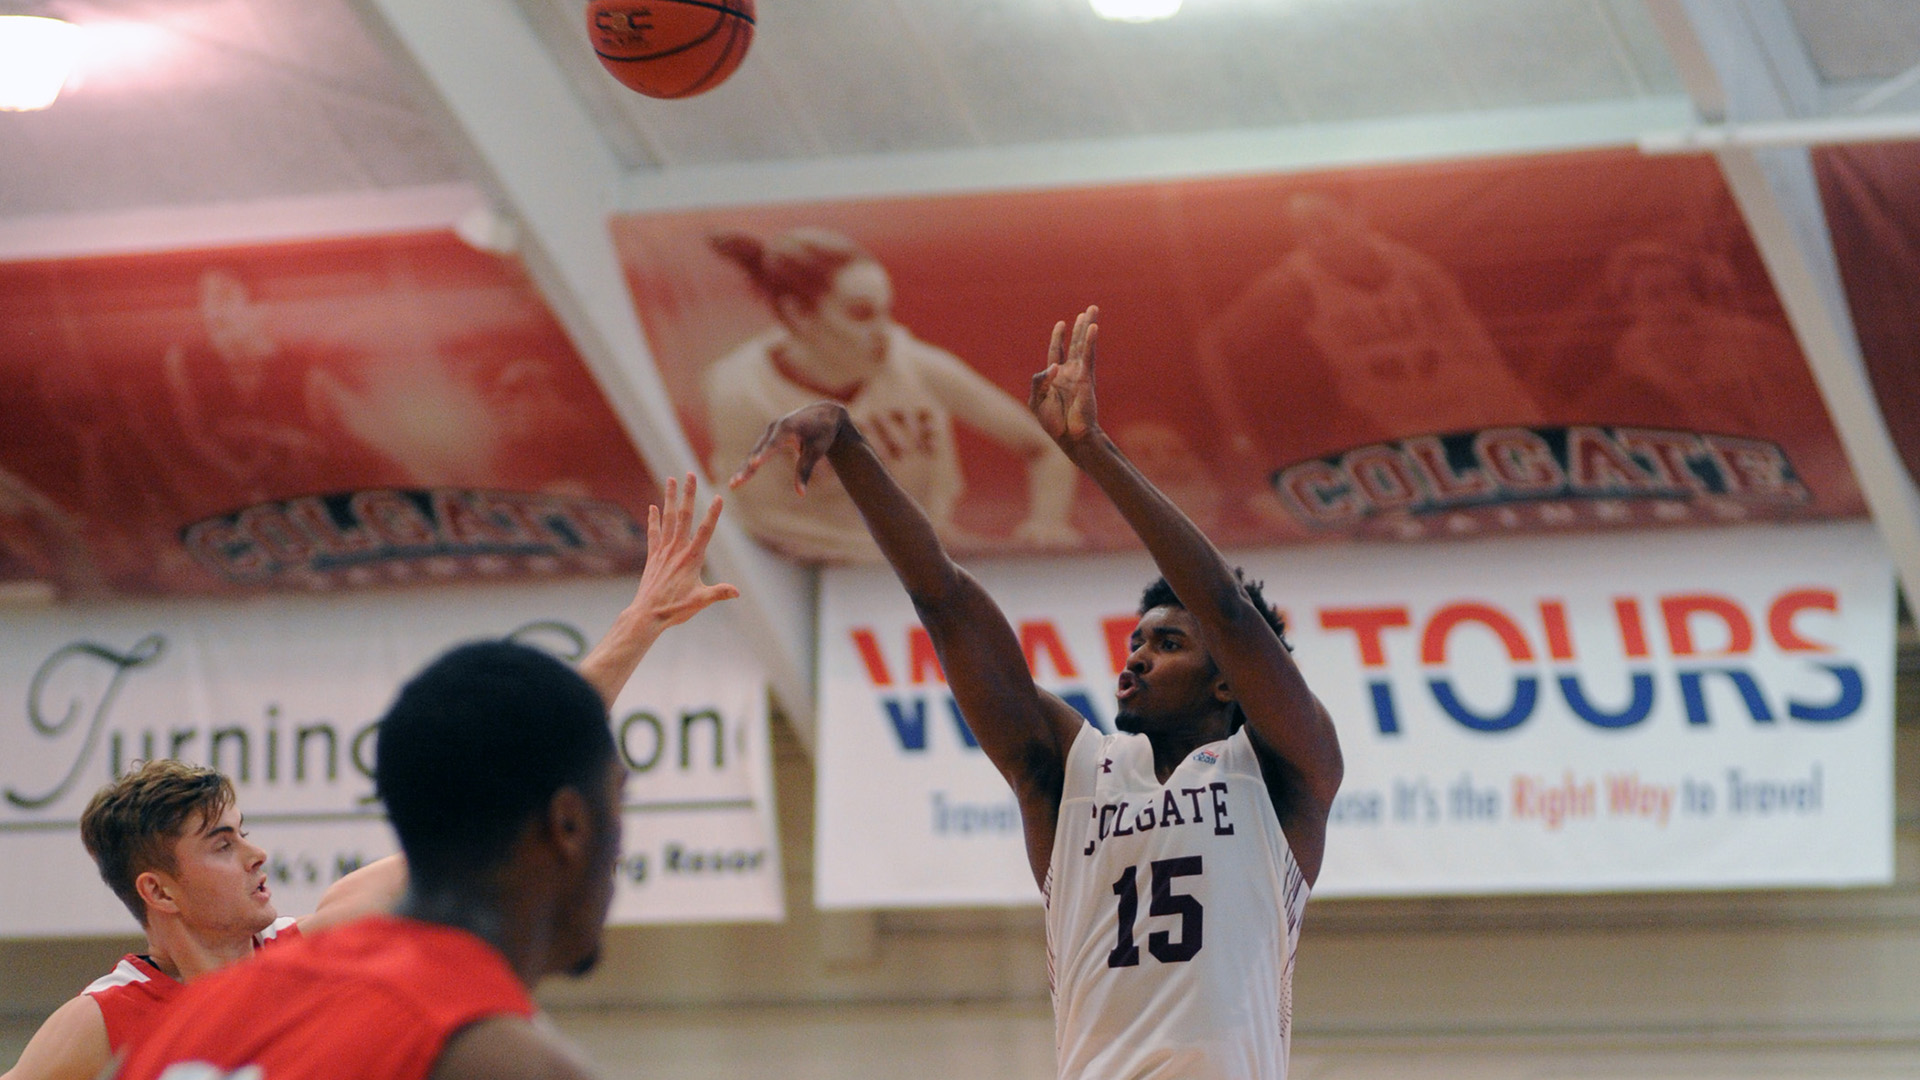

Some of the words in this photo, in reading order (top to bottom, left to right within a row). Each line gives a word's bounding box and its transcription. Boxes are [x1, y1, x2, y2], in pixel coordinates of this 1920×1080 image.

[1274, 425, 1811, 532] COLGATE
[182, 488, 642, 583] COLGATE
[1316, 584, 1867, 739] TOURS
[1391, 774, 1440, 823] It's
[1448, 771, 1500, 822] the
[1511, 768, 1597, 830] Right
[1604, 770, 1674, 829] Way
[1682, 774, 1717, 816] to
[1725, 761, 1824, 815] Travel
[1108, 856, 1203, 968] 15
